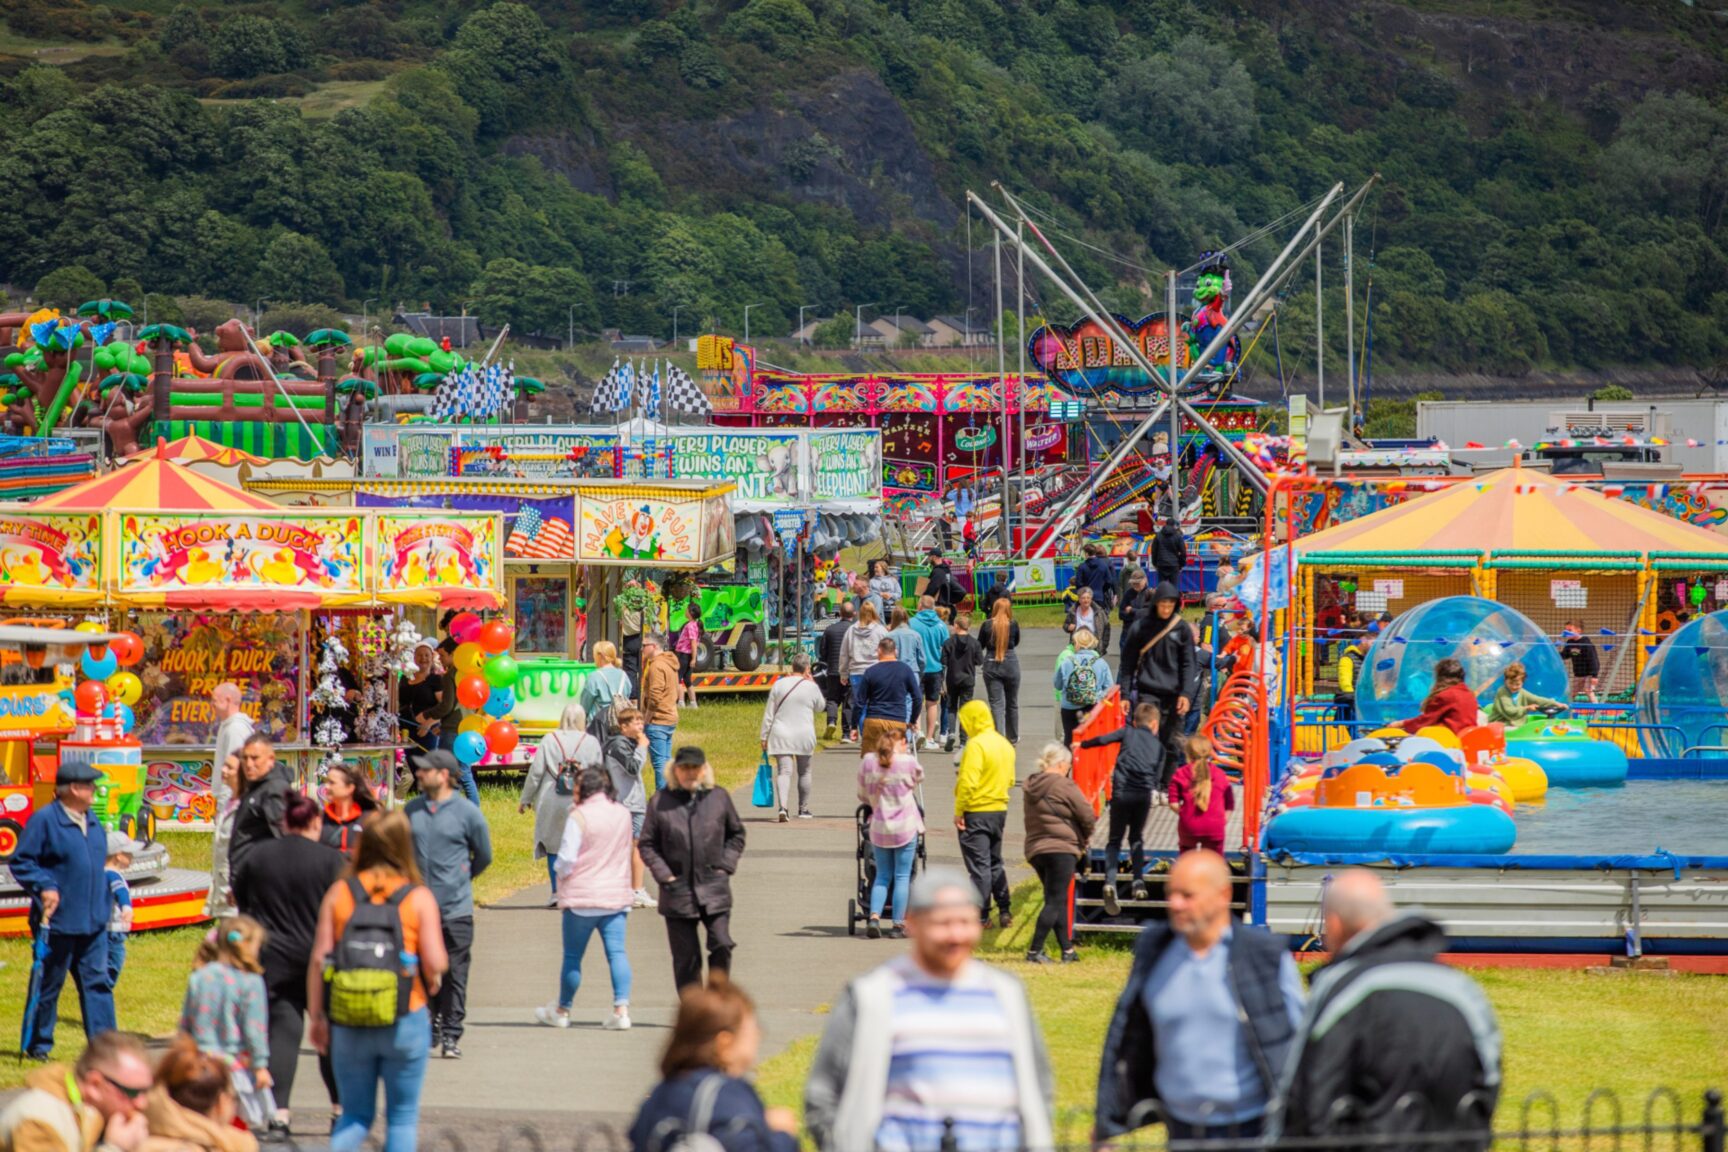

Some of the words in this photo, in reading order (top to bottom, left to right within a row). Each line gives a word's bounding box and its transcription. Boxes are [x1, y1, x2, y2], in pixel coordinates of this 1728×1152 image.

[883, 424, 930, 436] WALTZER
[1026, 432, 1058, 448] WALTZER
[374, 446, 391, 457] WIN
[711, 435, 768, 456] PLAYER
[819, 435, 840, 453] EVERY
[841, 433, 865, 452] PLAYER
[679, 455, 722, 473] WINS
[826, 453, 845, 470] WINS
[818, 468, 868, 497] ELEPHANT
[585, 502, 626, 552] HAVE
[661, 507, 691, 554] FUN
[27, 525, 67, 554] TIME
[160, 523, 229, 555] HOOK
[234, 524, 252, 539] A
[255, 523, 325, 556] DUCK
[160, 650, 210, 672] HOOK
[212, 650, 226, 672] A
[229, 650, 277, 672] DUCK
[188, 678, 251, 695] PRE
